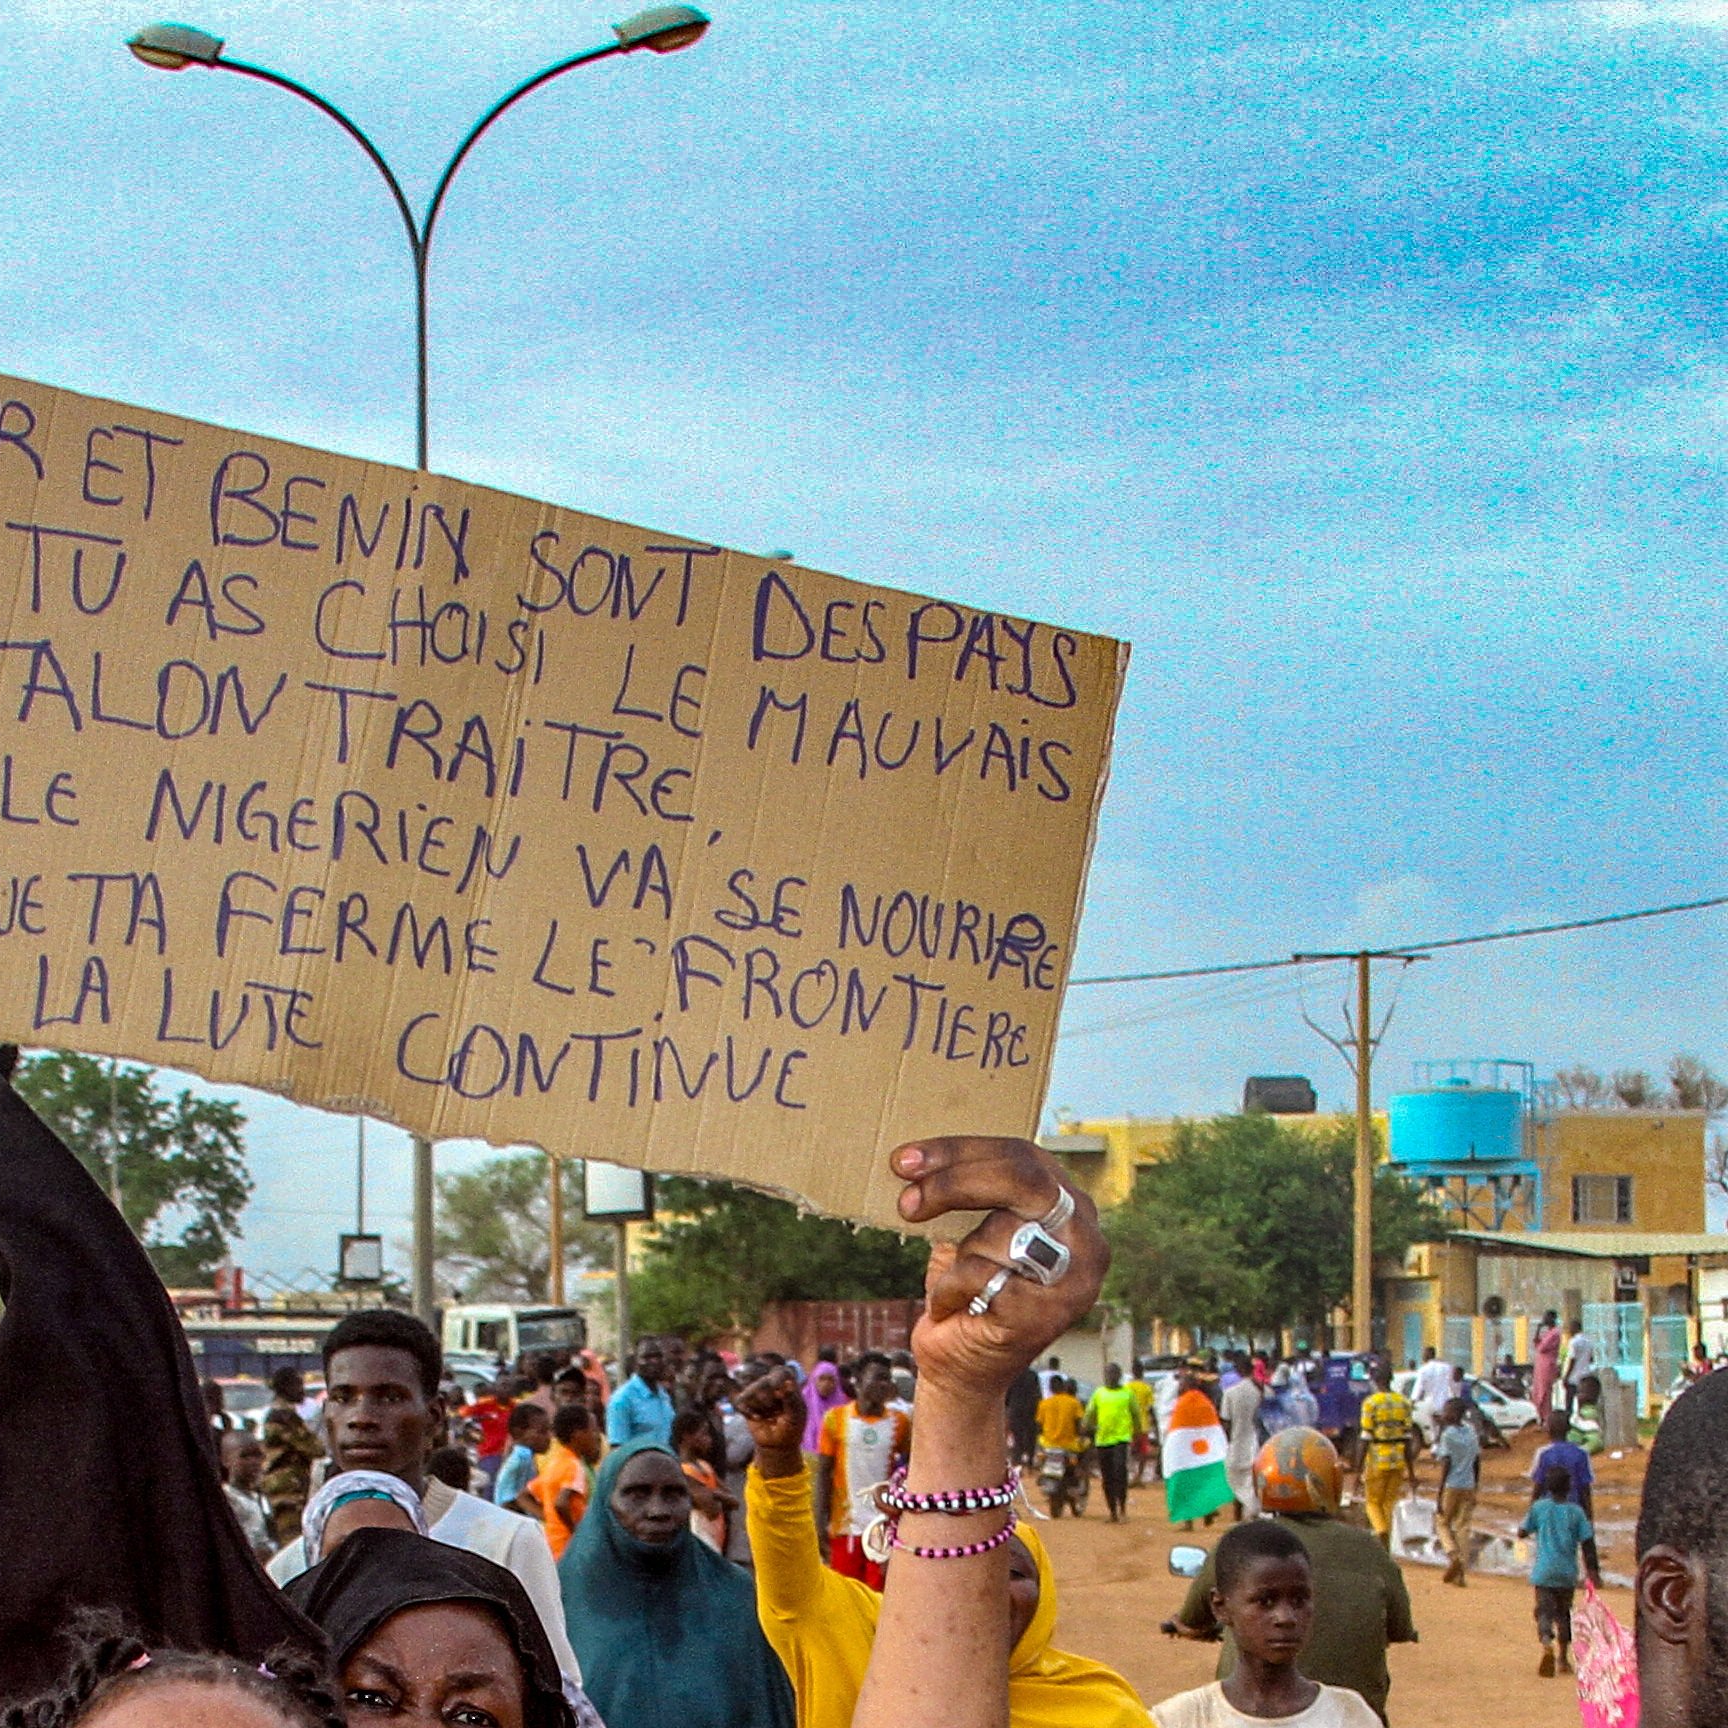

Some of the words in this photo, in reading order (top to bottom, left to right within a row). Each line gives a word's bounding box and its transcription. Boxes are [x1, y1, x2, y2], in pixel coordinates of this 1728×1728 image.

[6, 521, 126, 615] TU
[166, 558, 264, 640] AS
[315, 579, 544, 684] CHOISI
[613, 644, 706, 739] LE
[82, 425, 184, 521] ET
[517, 531, 721, 627] SONT
[752, 569, 887, 664] DES
[907, 601, 1077, 709] PAYS
[67, 871, 167, 956] TA
[215, 871, 499, 974] FERME
[673, 934, 1029, 1069] FRONTIERE
[714, 868, 806, 937] SE
[33, 955, 110, 1030] LA
[157, 968, 322, 1051] LUTE
